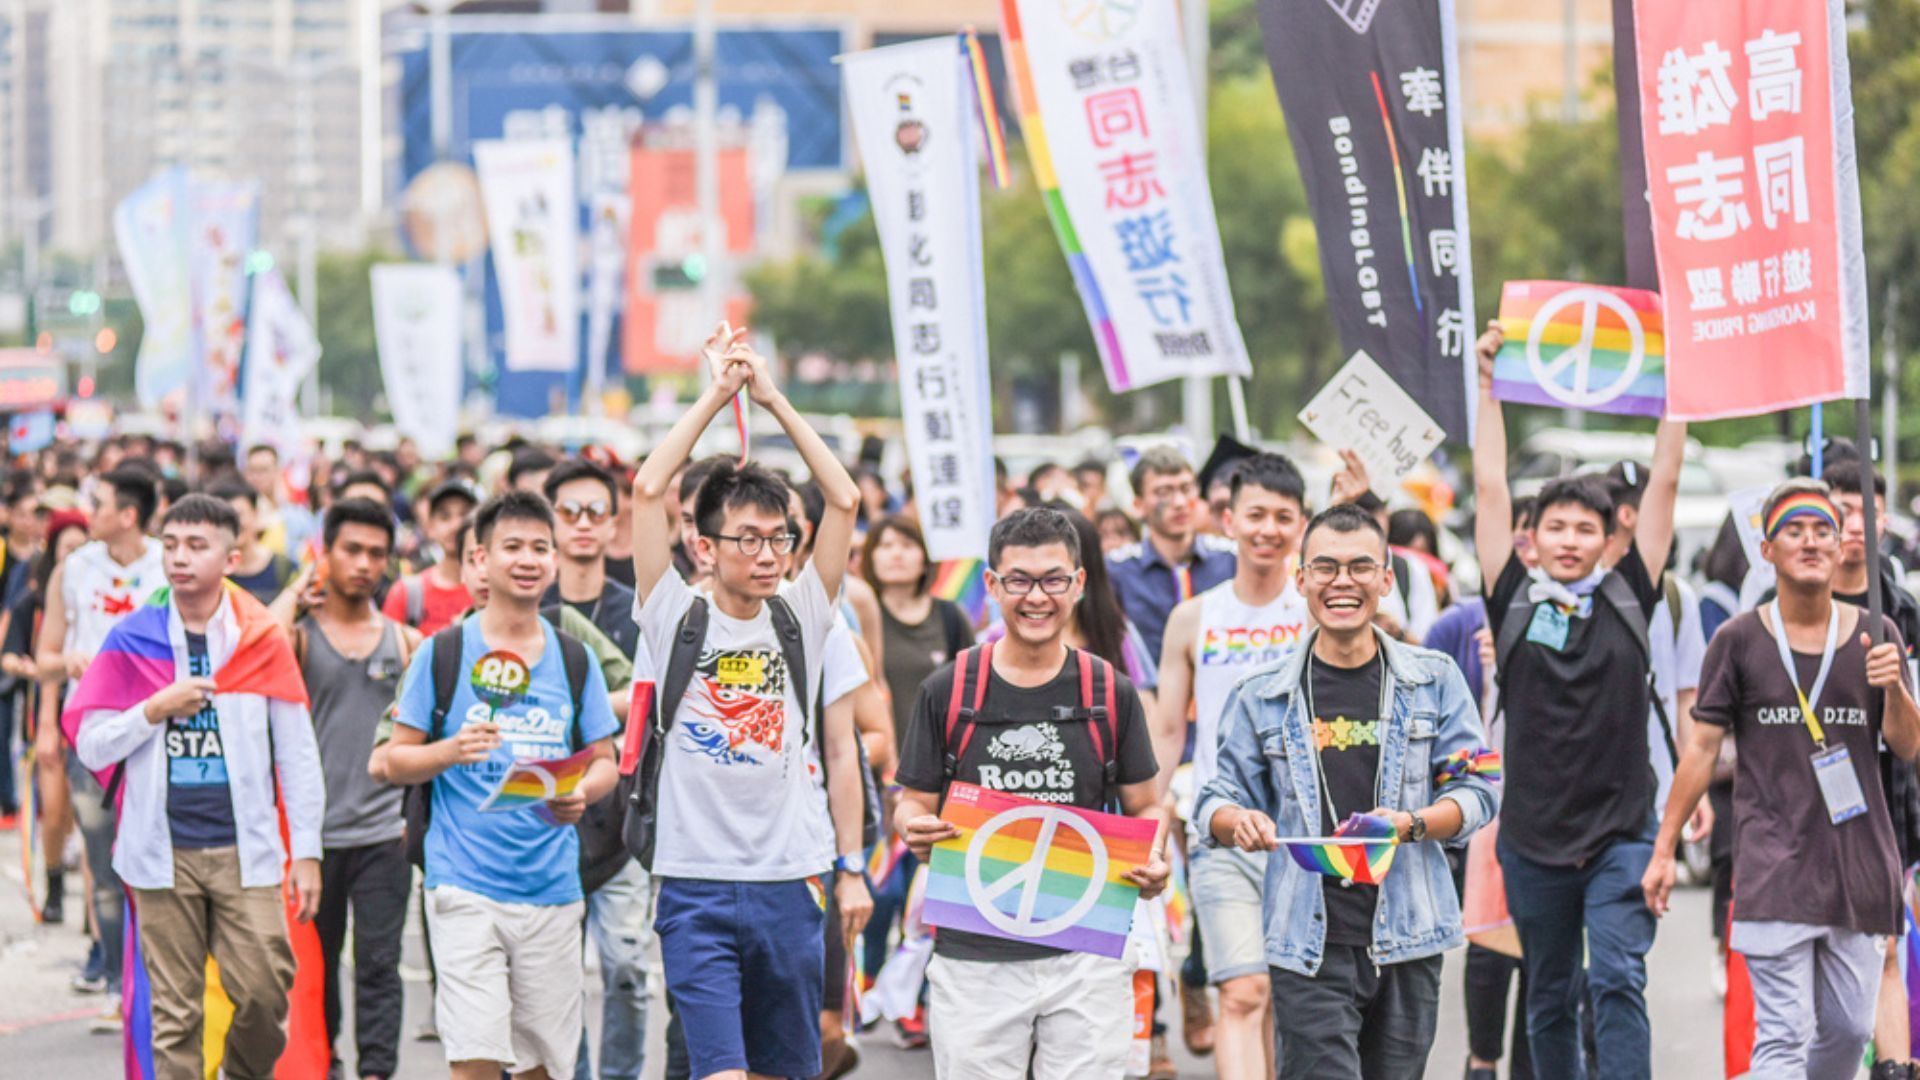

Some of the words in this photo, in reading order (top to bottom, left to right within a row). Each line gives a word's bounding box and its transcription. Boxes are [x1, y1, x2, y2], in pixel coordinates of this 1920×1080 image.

[1331, 373, 1390, 440] Free
[479, 656, 525, 689] RD
[1757, 706, 1812, 725] CARP
[977, 764, 1075, 790] Roots
